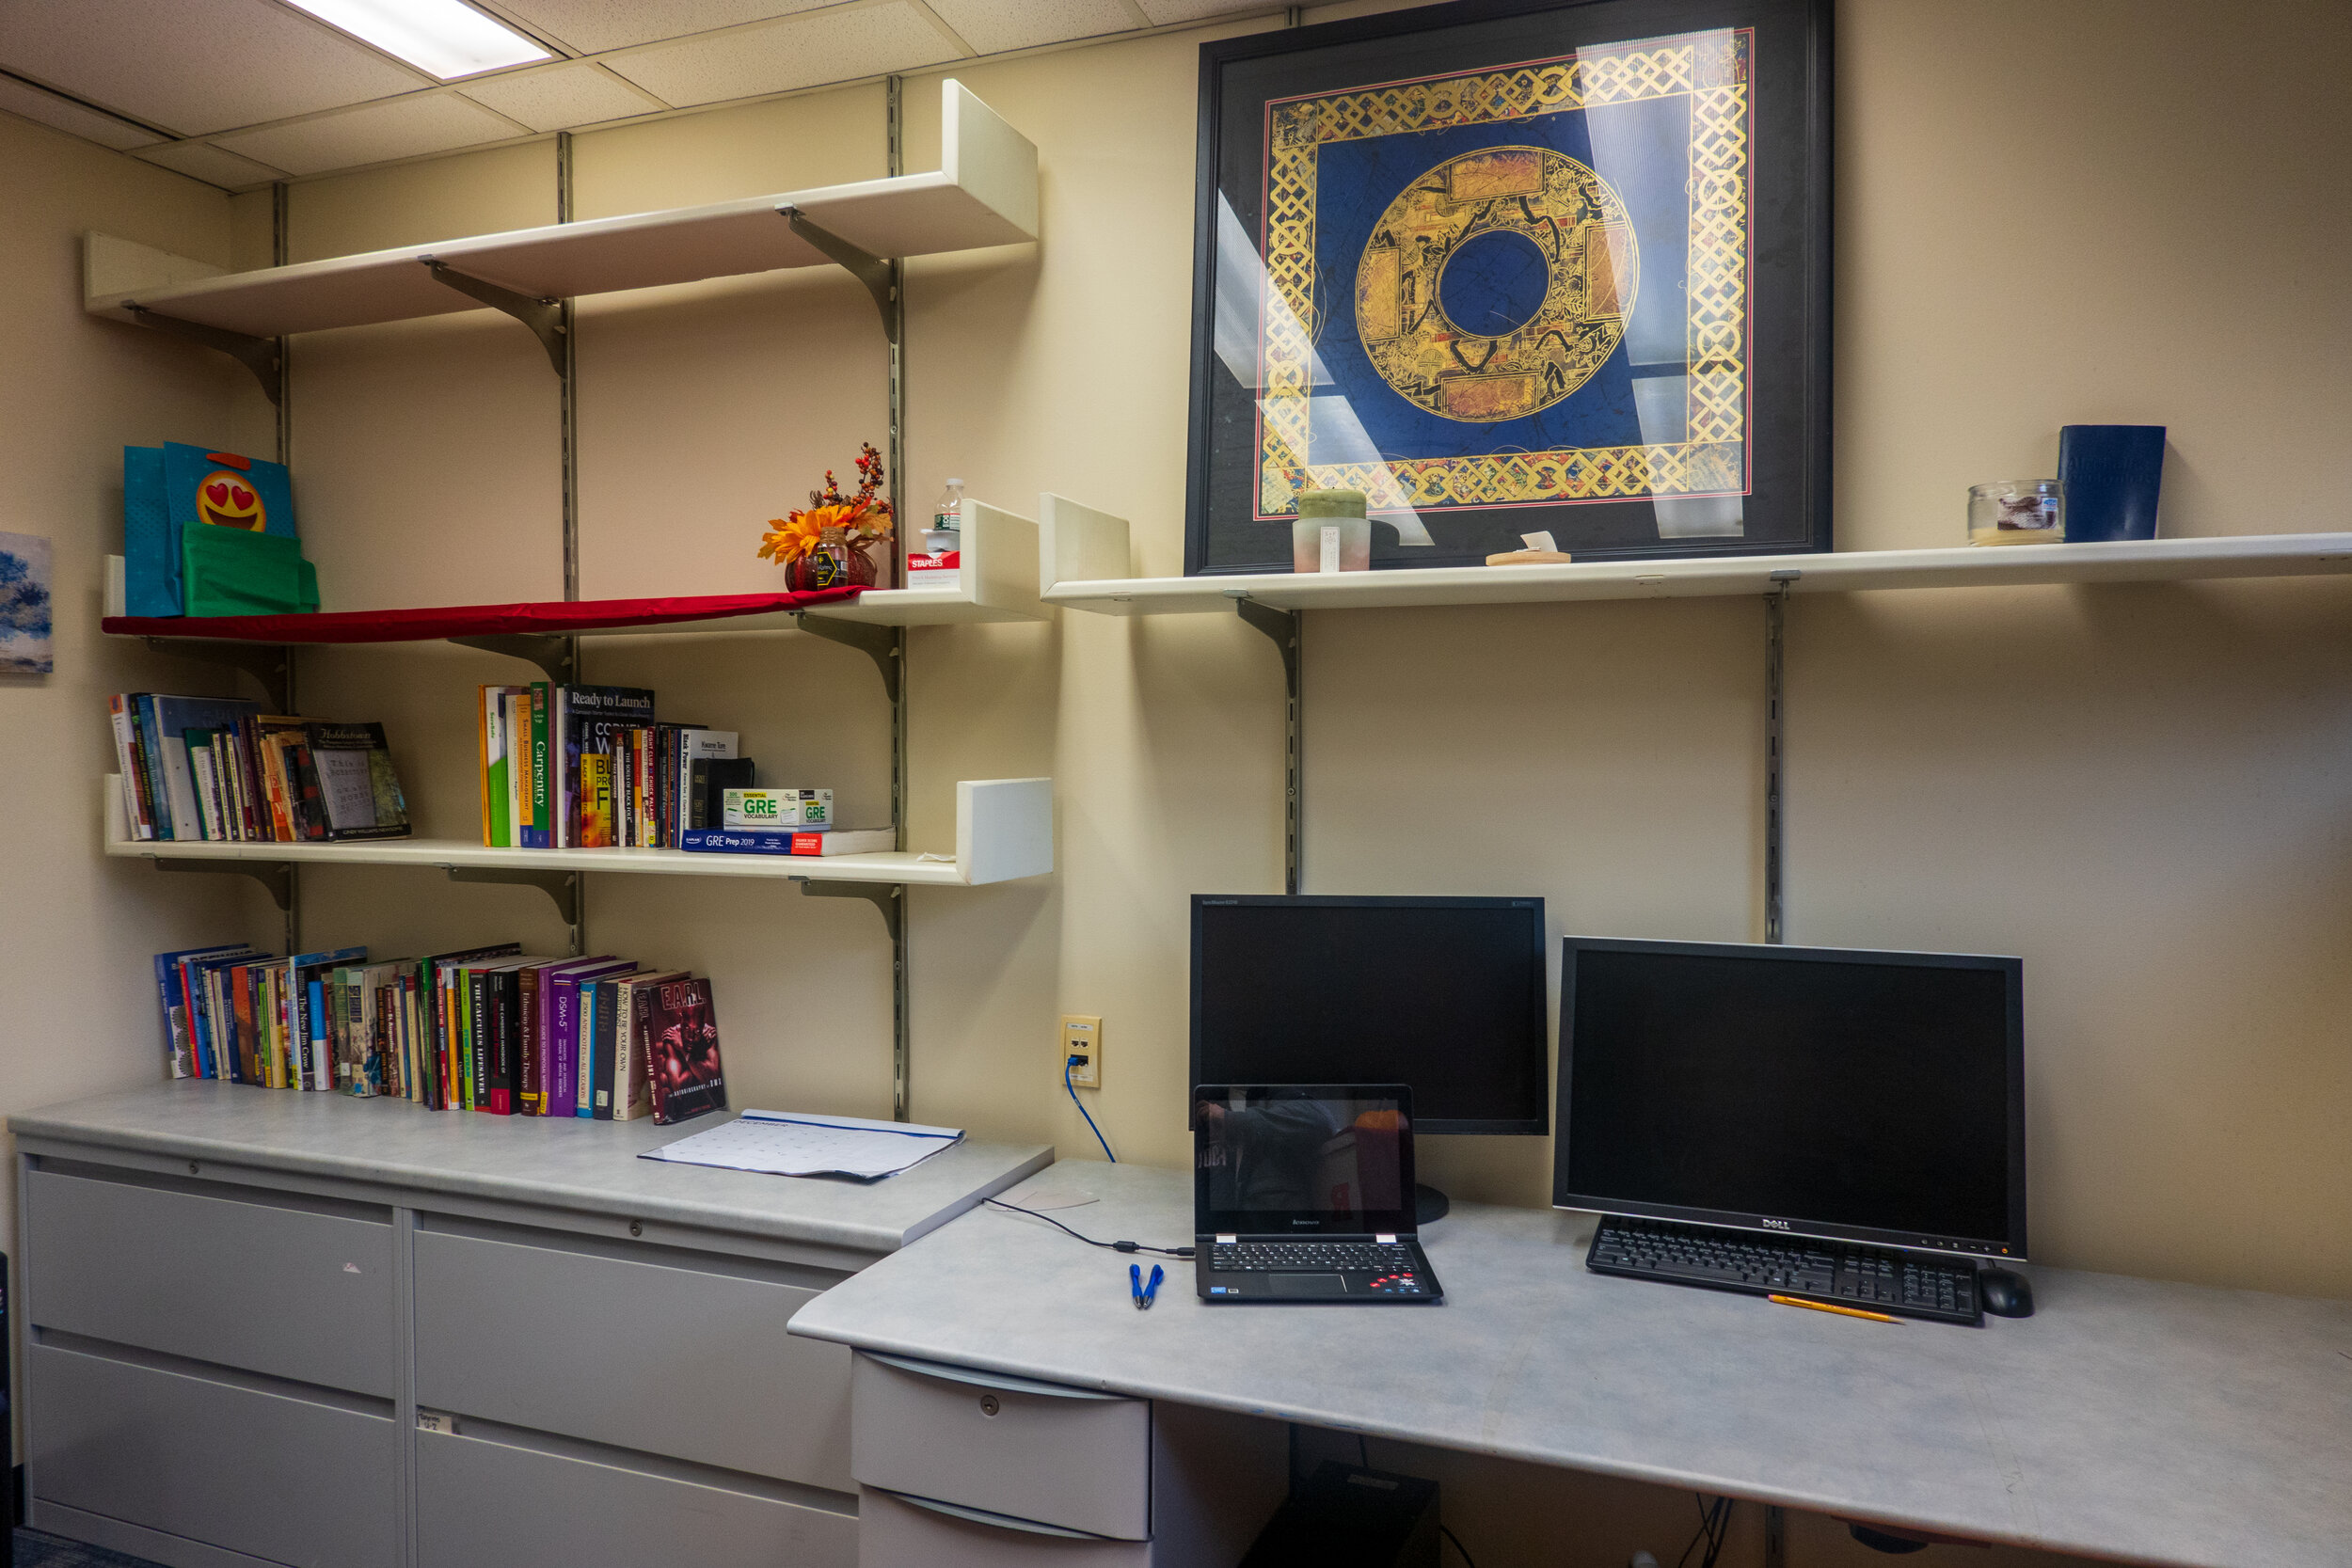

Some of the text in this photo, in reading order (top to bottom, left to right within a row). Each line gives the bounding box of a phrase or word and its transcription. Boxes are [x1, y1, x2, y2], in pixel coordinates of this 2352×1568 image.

[912, 559, 944, 568] STAPLES
[572, 691, 651, 708] Ready to Launch
[533, 740, 546, 807] Carpentry
[744, 800, 777, 814] GRE
[805, 806, 825, 819] GRE
[706, 834, 723, 847] GRE
[724, 837, 739, 847] Prep
[740, 837, 755, 847] 2019
[660, 981, 707, 1011] E.A.R.L.
[521, 992, 530, 1025] Ethnicity
[621, 1007, 628, 1019] TO
[475, 1003, 484, 1045] CALCULUS
[621, 1020, 628, 1030] BE
[298, 996, 310, 1068] The New Jim Crow
[674, 1077, 722, 1097] AUTOBIOGRAPHY DMX
[733, 1119, 789, 1128] DECEMBER
[1762, 1219, 1791, 1230] DELL
